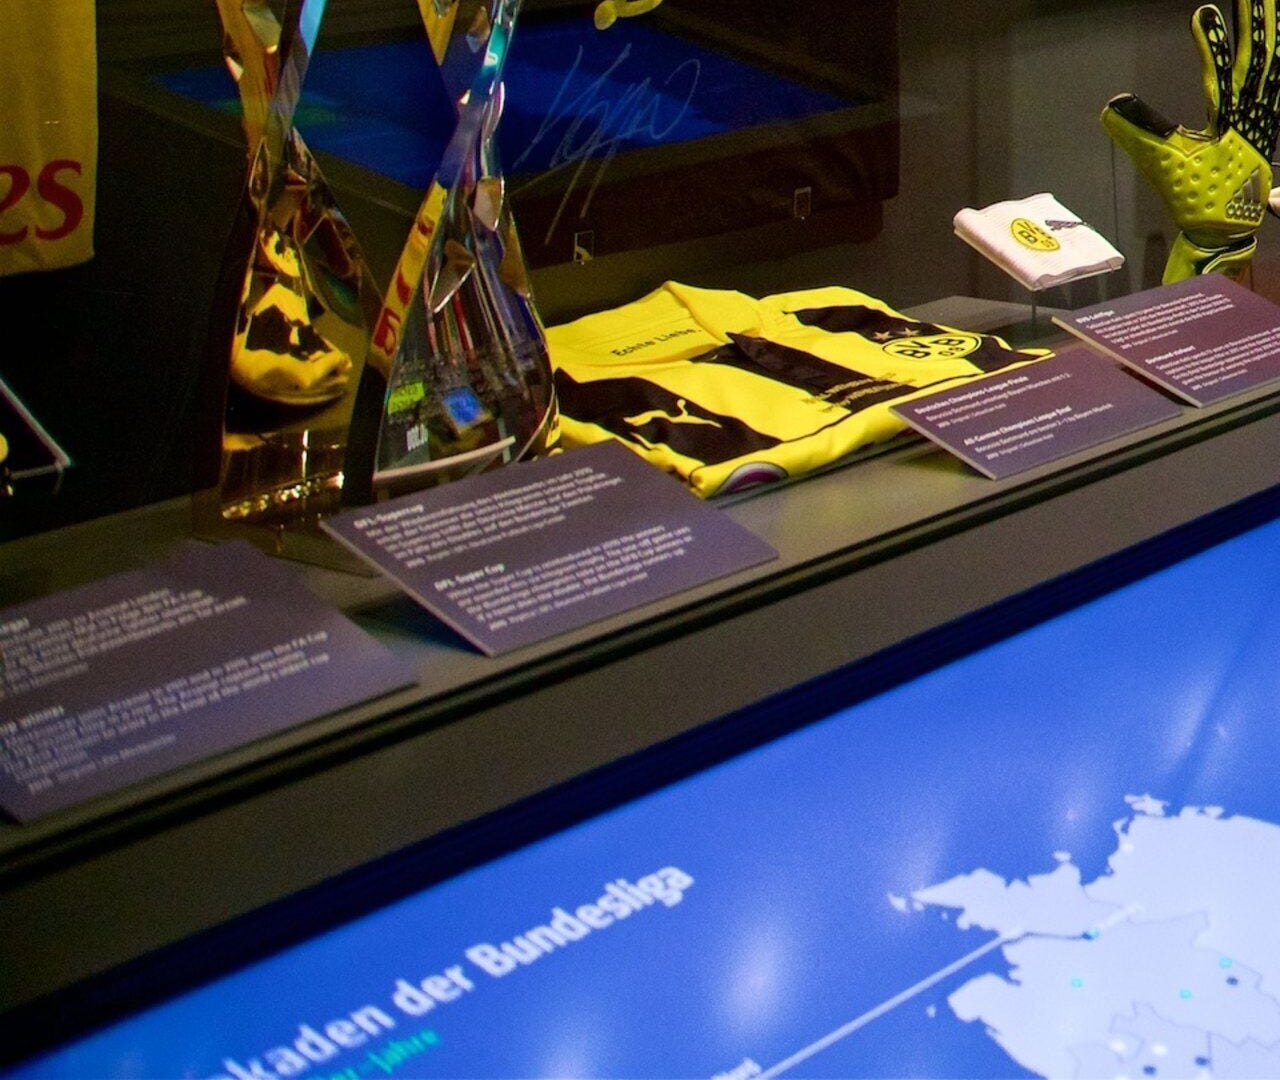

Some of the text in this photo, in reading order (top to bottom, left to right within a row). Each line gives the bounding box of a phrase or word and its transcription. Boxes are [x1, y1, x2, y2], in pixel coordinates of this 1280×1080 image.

[611, 341, 656, 356] Echte
[893, 337, 967, 359] BVB
[393, 964, 474, 1016] der
[467, 866, 694, 977] Bundesliga
